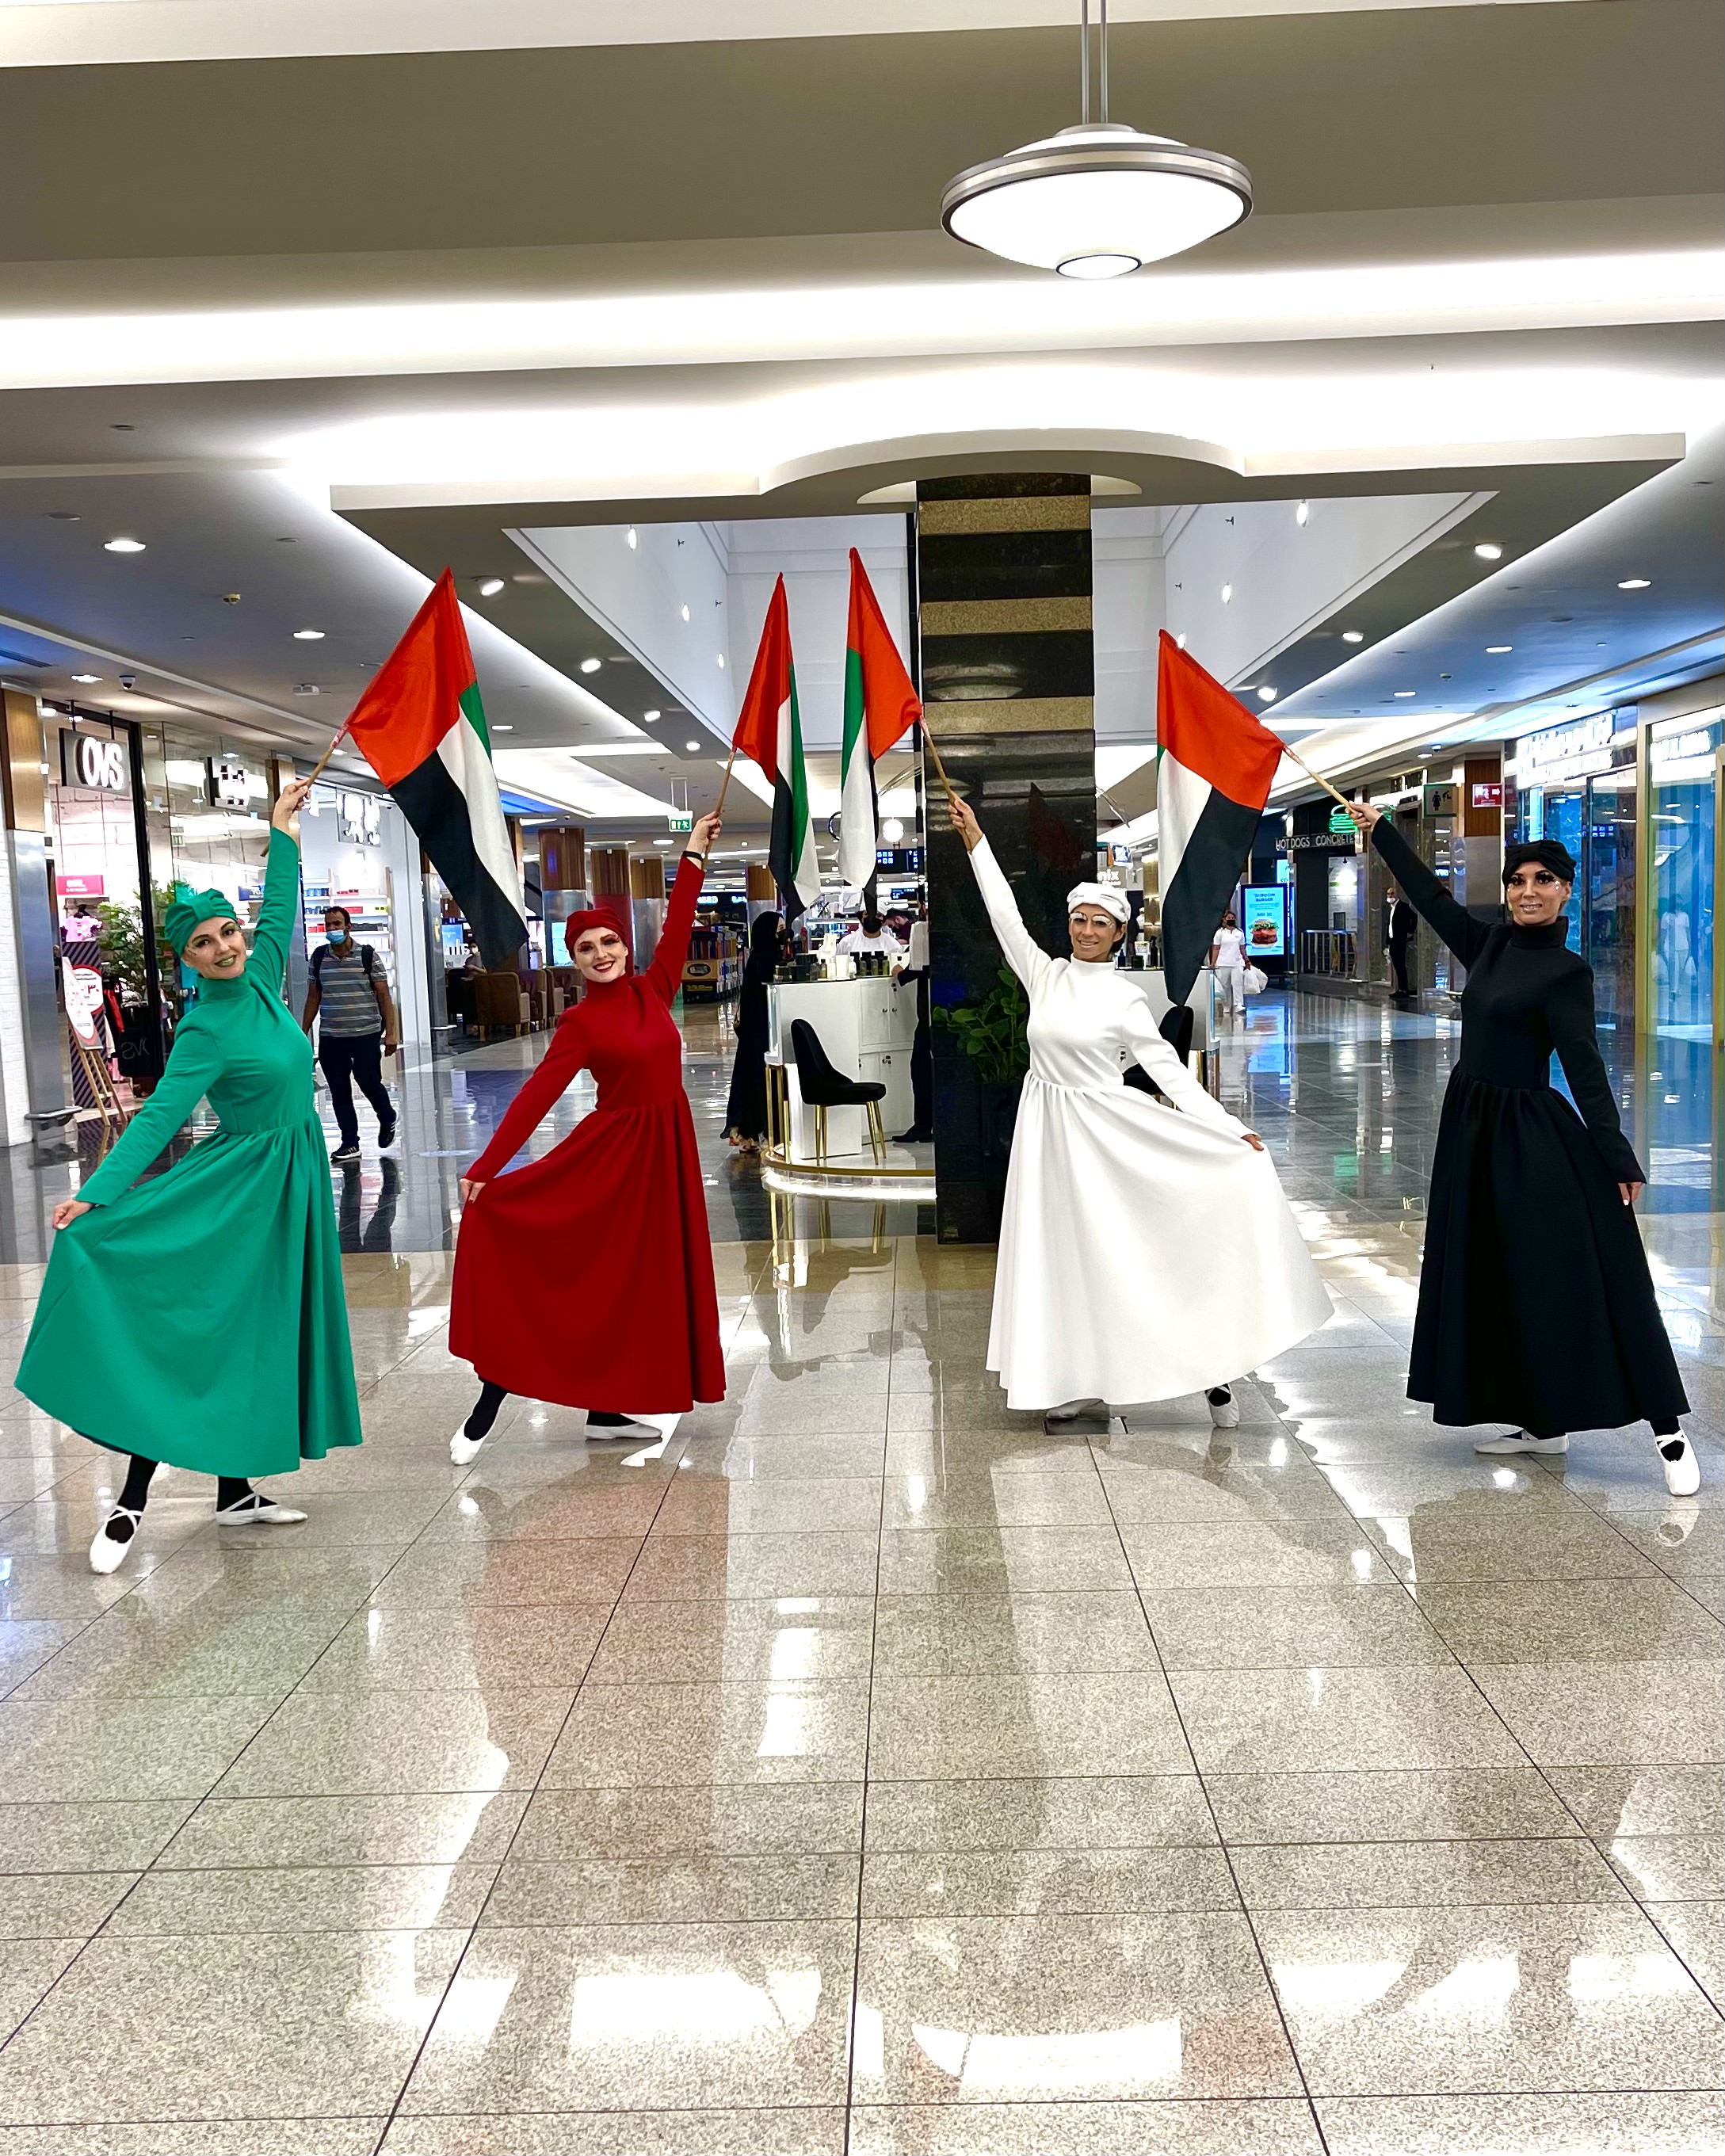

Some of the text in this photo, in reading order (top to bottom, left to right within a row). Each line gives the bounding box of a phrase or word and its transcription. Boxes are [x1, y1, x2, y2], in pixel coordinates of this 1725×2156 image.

[82, 736, 124, 790] OVS
[1276, 838, 1290, 851] HOT
[1290, 836, 1311, 849] DOGS
